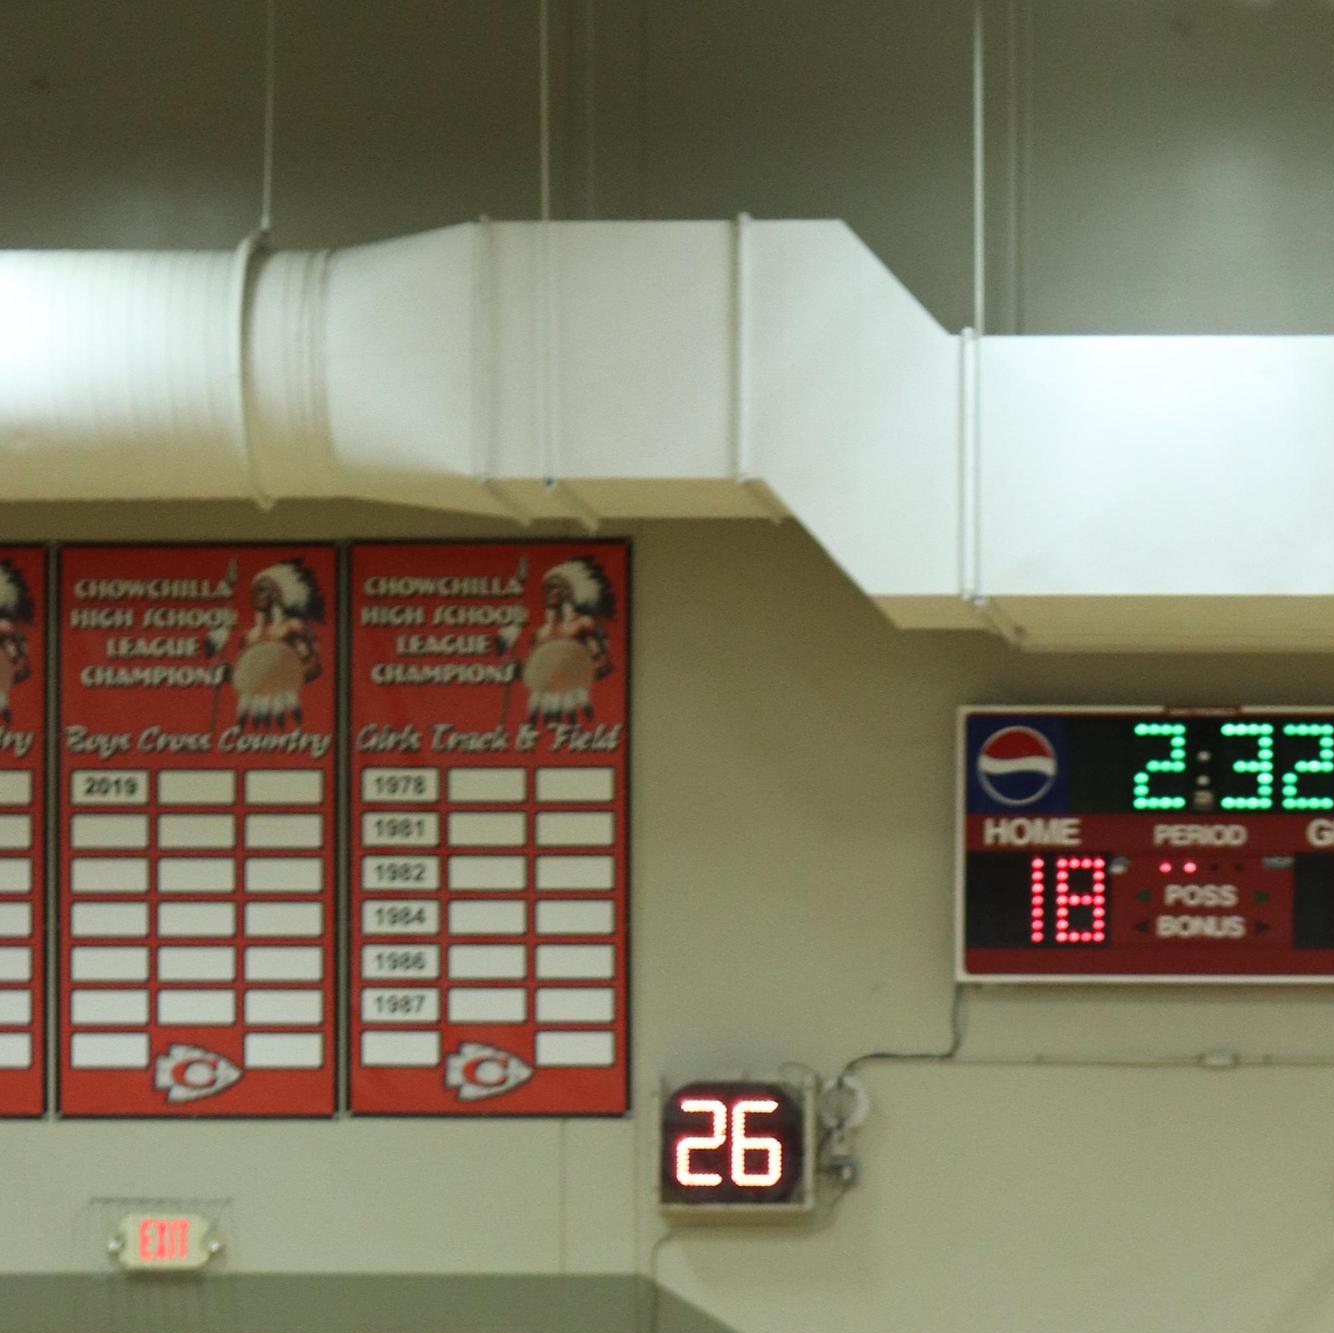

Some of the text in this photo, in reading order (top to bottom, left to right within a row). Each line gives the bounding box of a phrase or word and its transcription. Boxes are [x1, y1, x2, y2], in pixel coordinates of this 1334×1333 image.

[74, 579, 232, 599] CHOWCHILLA
[364, 577, 523, 596] CHOWCHILLA
[70, 607, 237, 628] HIGH SCHOOL
[361, 605, 527, 626] HIGH SCHOOL
[107, 637, 199, 657] LEAGUE
[397, 634, 489, 655] LEAGUE
[81, 665, 226, 687] CHAMPIONS
[371, 663, 517, 685] CHAMPIONS
[65, 725, 331, 757] Boys Cross Country
[356, 723, 421, 751] Girls
[431, 723, 509, 751] Track
[546, 723, 623, 751] Field
[1133, 722, 1334, 810] 2:32
[85, 777, 138, 796] 2019
[375, 775, 427, 794] 1978
[983, 818, 1081, 846] HOME
[1153, 824, 1248, 846] PERIOD
[1031, 856, 1105, 943] 18
[1163, 885, 1239, 907] POSS
[1156, 915, 1246, 939] BONUS
[676, 1100, 782, 1187] 26
[139, 1217, 191, 1261] EXIT
